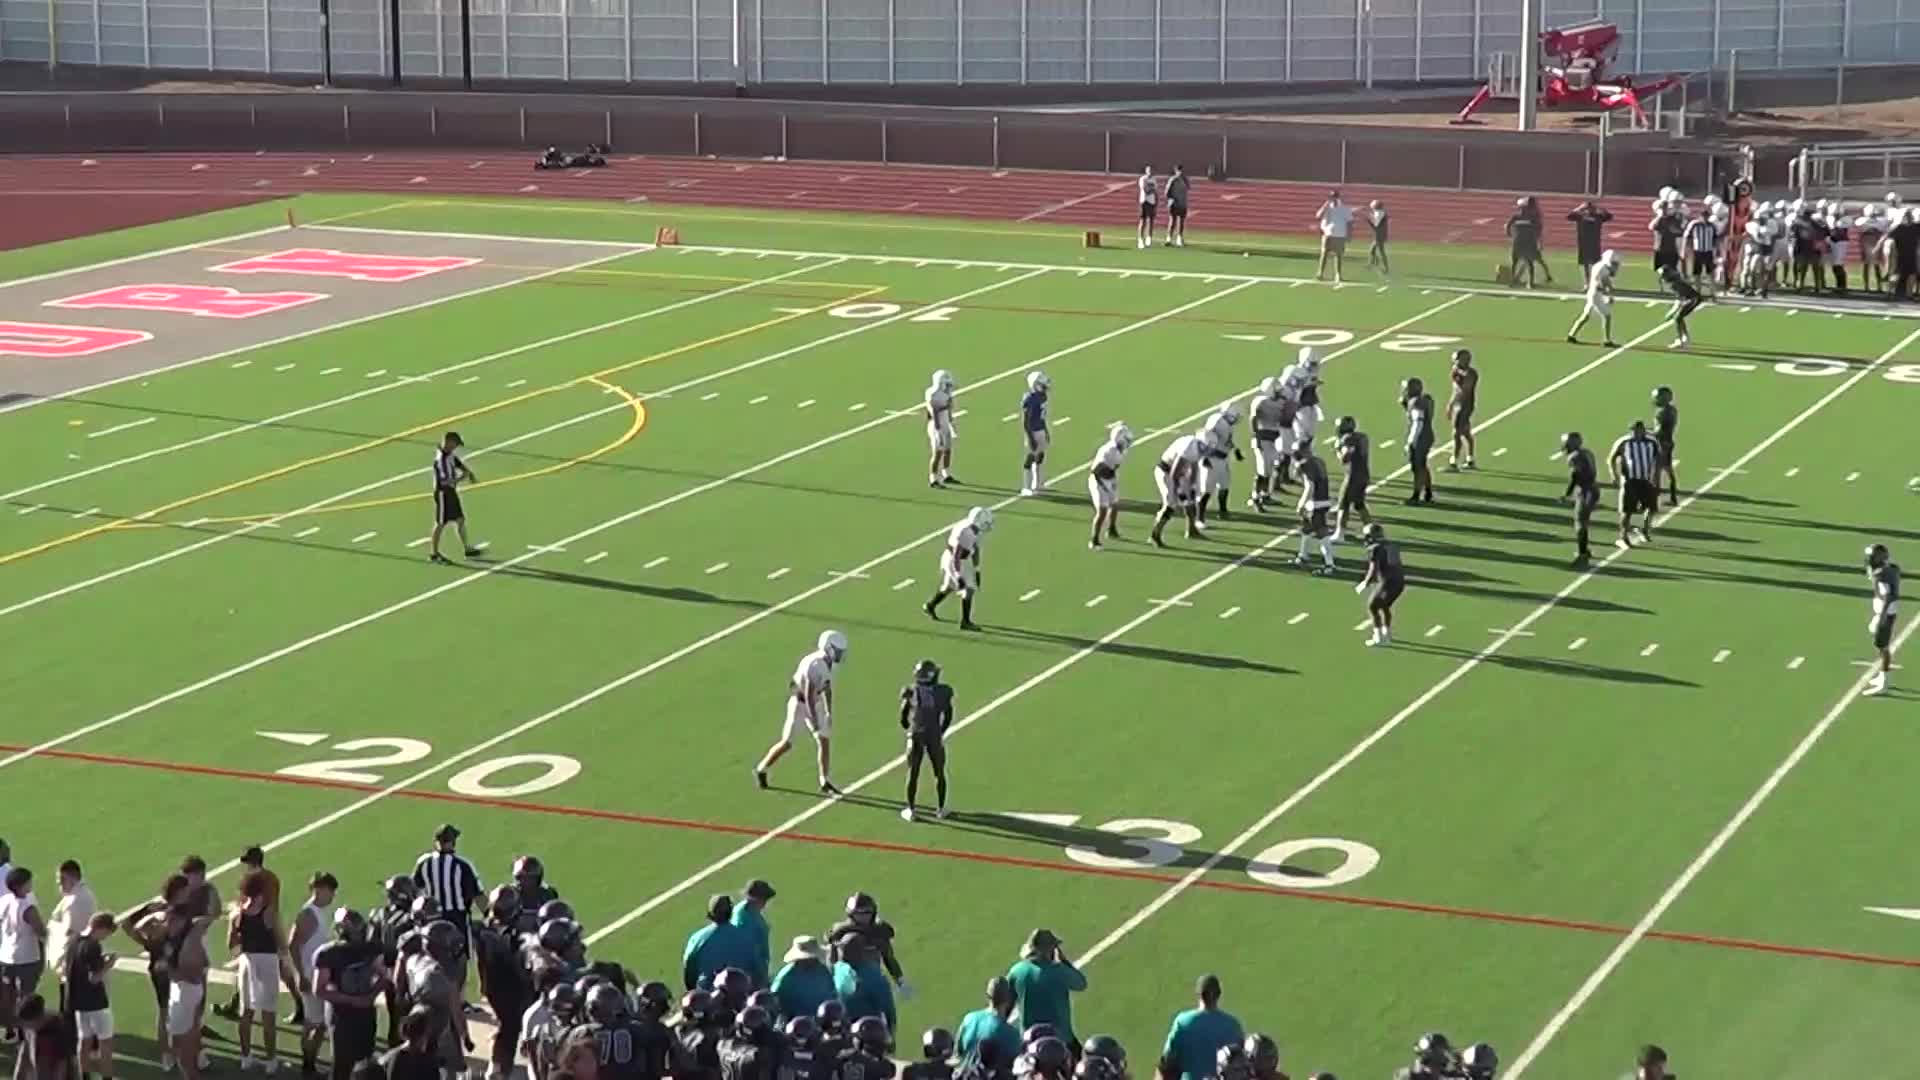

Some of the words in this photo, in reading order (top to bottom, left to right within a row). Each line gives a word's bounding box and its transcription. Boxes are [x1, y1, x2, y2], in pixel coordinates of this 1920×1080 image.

[1280, 329, 1463, 352] 20
[275, 737, 581, 797] 20
[1065, 818, 1381, 887] 30
